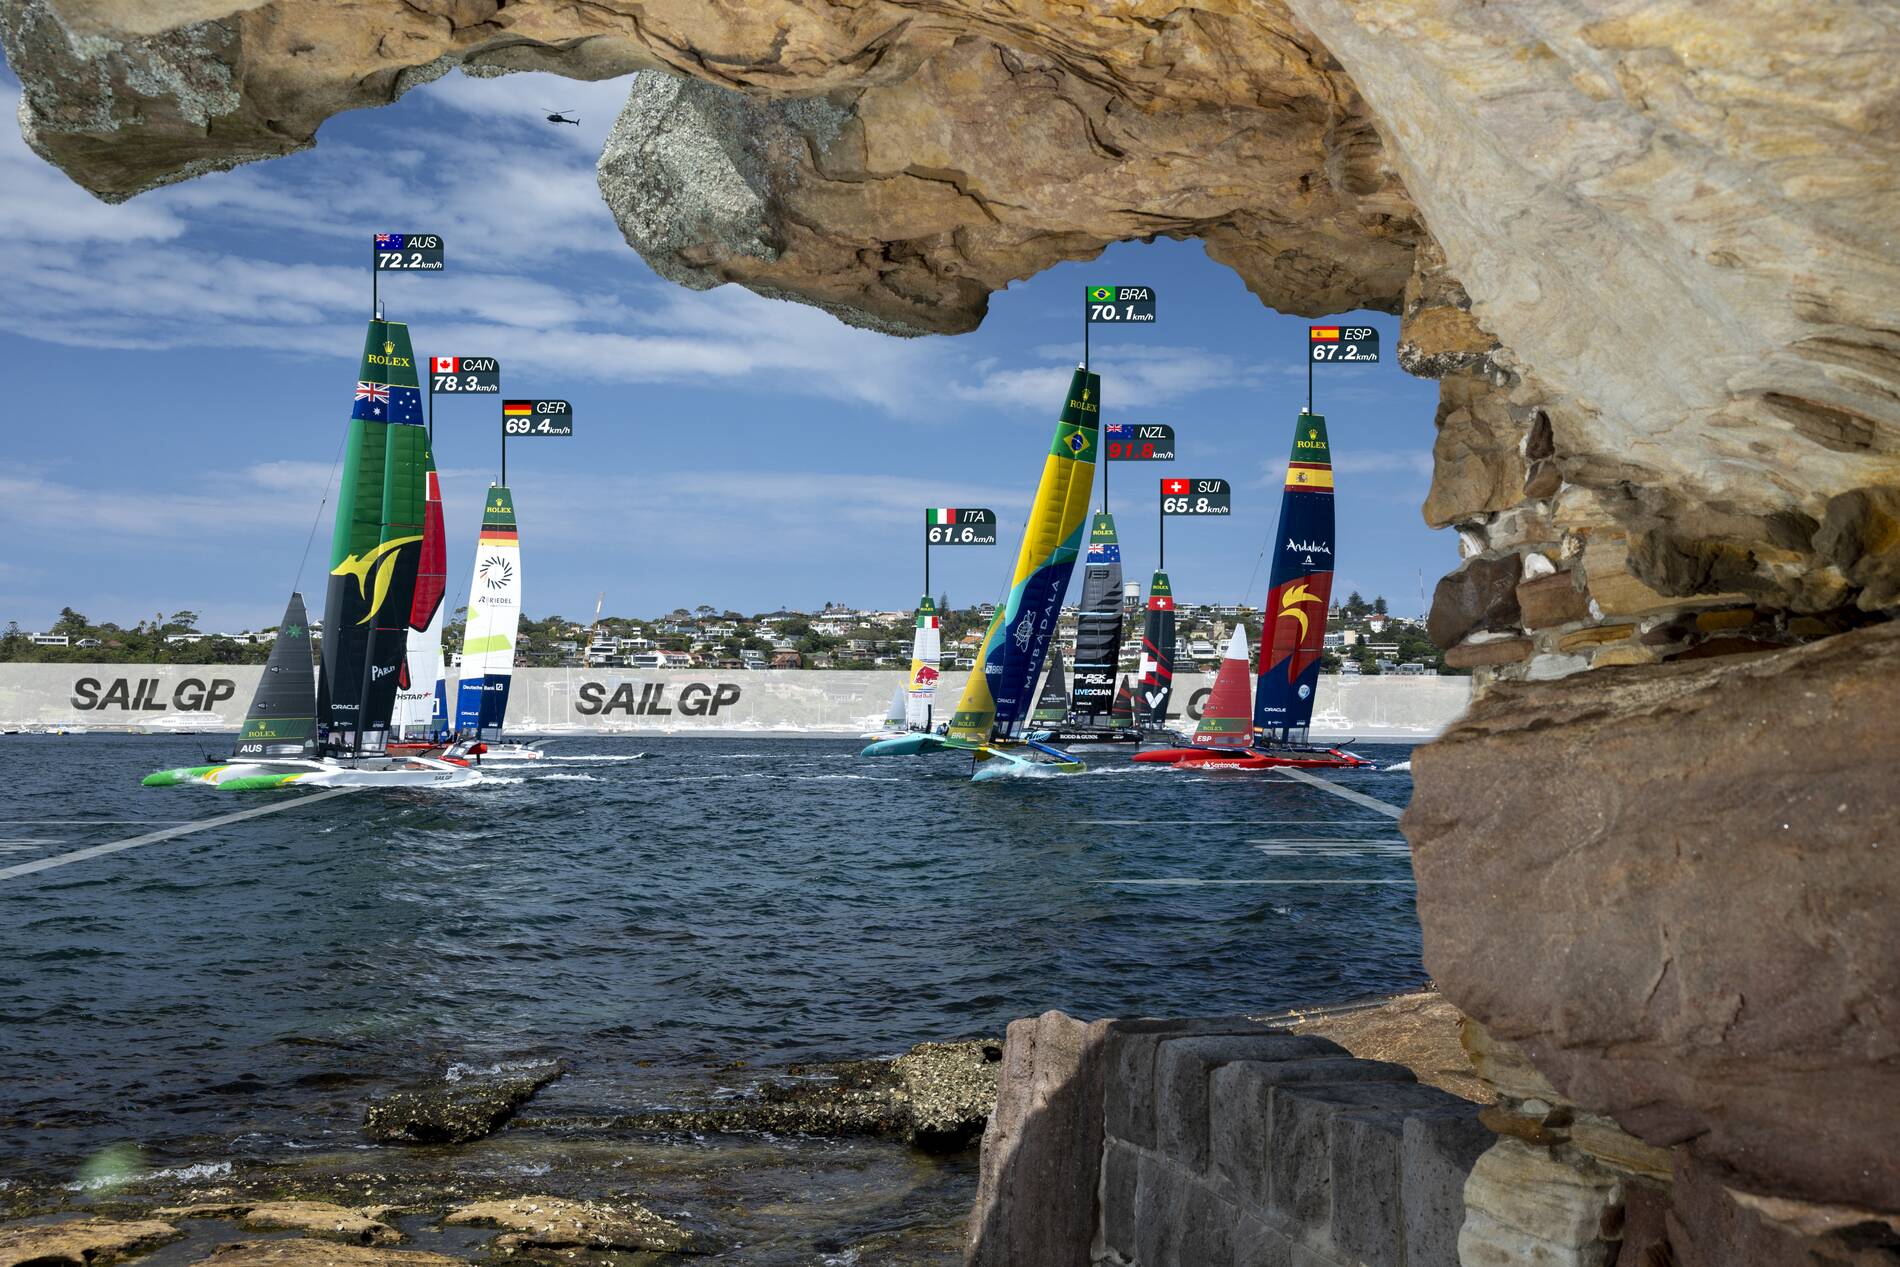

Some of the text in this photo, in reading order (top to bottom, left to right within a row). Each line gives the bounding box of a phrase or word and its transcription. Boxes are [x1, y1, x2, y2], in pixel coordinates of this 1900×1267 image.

[367, 354, 411, 368] ROLEX
[1069, 399, 1097, 413] ROLEX
[1296, 440, 1327, 449] ROLEX
[1024, 579, 1061, 689] MUBADALA
[240, 744, 263, 753] AUS
